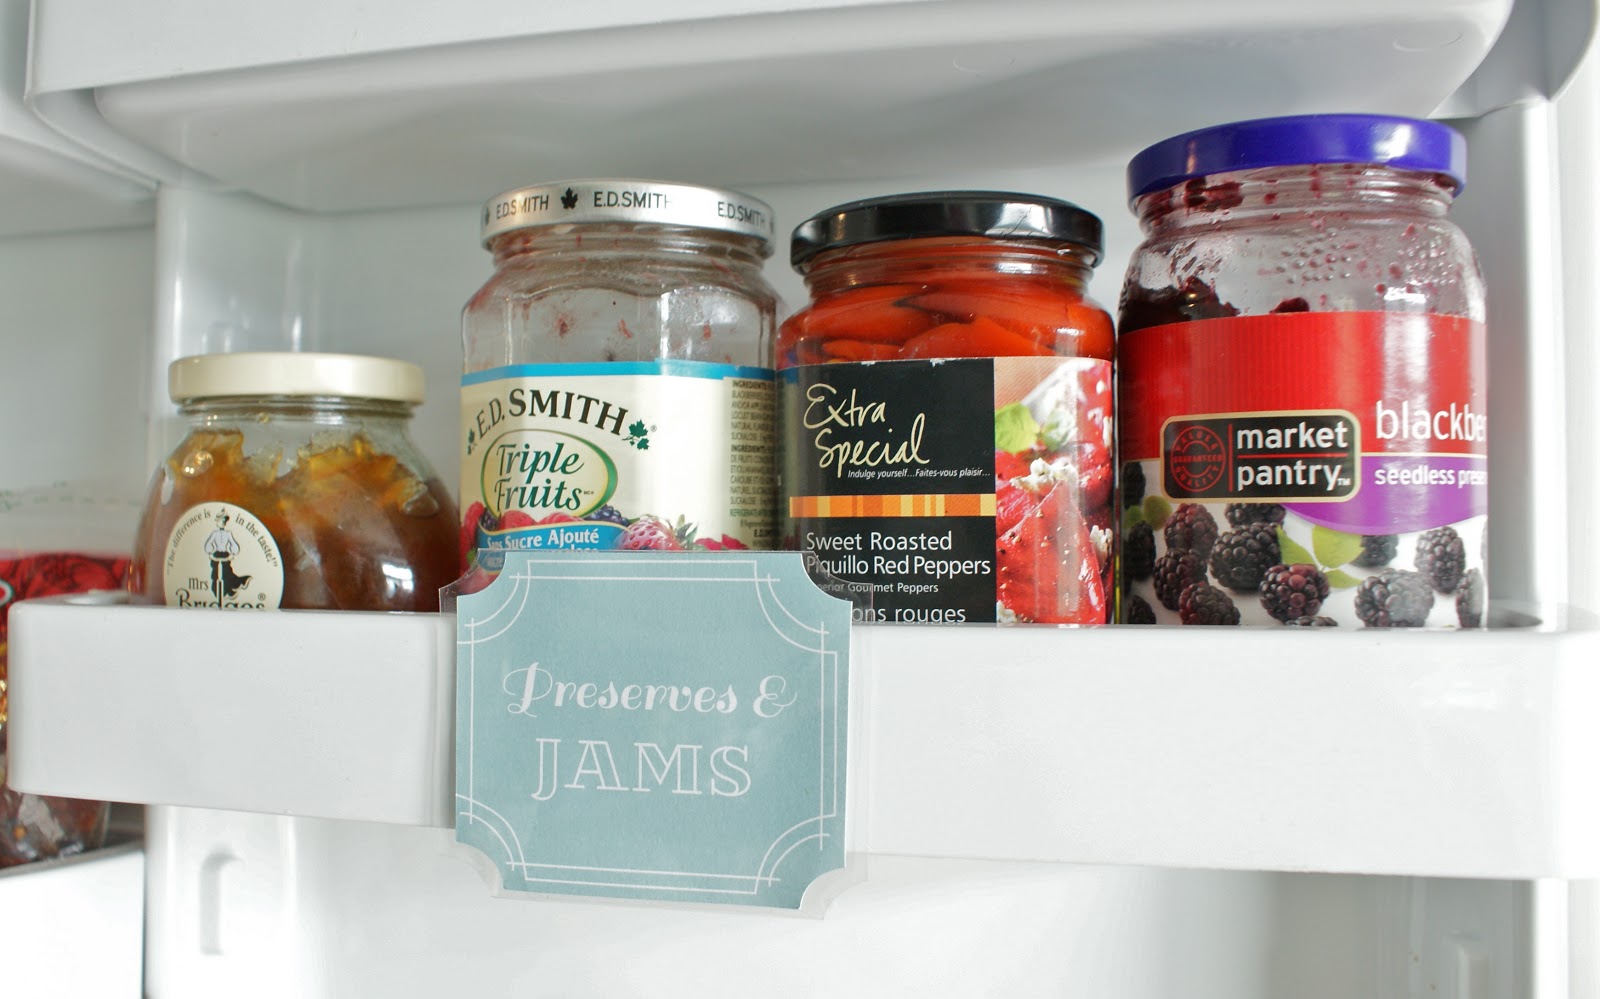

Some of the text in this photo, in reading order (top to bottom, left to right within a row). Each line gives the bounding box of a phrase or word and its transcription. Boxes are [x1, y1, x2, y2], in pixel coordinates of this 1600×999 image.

[508, 388, 629, 436] SMITH
[803, 383, 886, 429] Extra
[815, 413, 930, 478] Special
[1237, 421, 1349, 449] market
[496, 442, 585, 485] Triple
[847, 469, 876, 480] Indulge
[1374, 465, 1455, 485] seedless
[494, 478, 582, 513] Fruits
[204, 508, 212, 519] is
[235, 513, 245, 526] in
[245, 521, 259, 537] the
[504, 534, 543, 550] Sucre
[547, 527, 600, 549] Ajouté
[806, 531, 863, 551] Sweet
[870, 530, 953, 551] Roasted
[806, 554, 991, 579] Piquillo Red Peppers
[188, 577, 209, 591] Mrs
[847, 582, 894, 593] Gourmet
[897, 582, 939, 594] Peppers
[503, 662, 797, 718] Preserves &
[531, 737, 751, 801] JAMS
